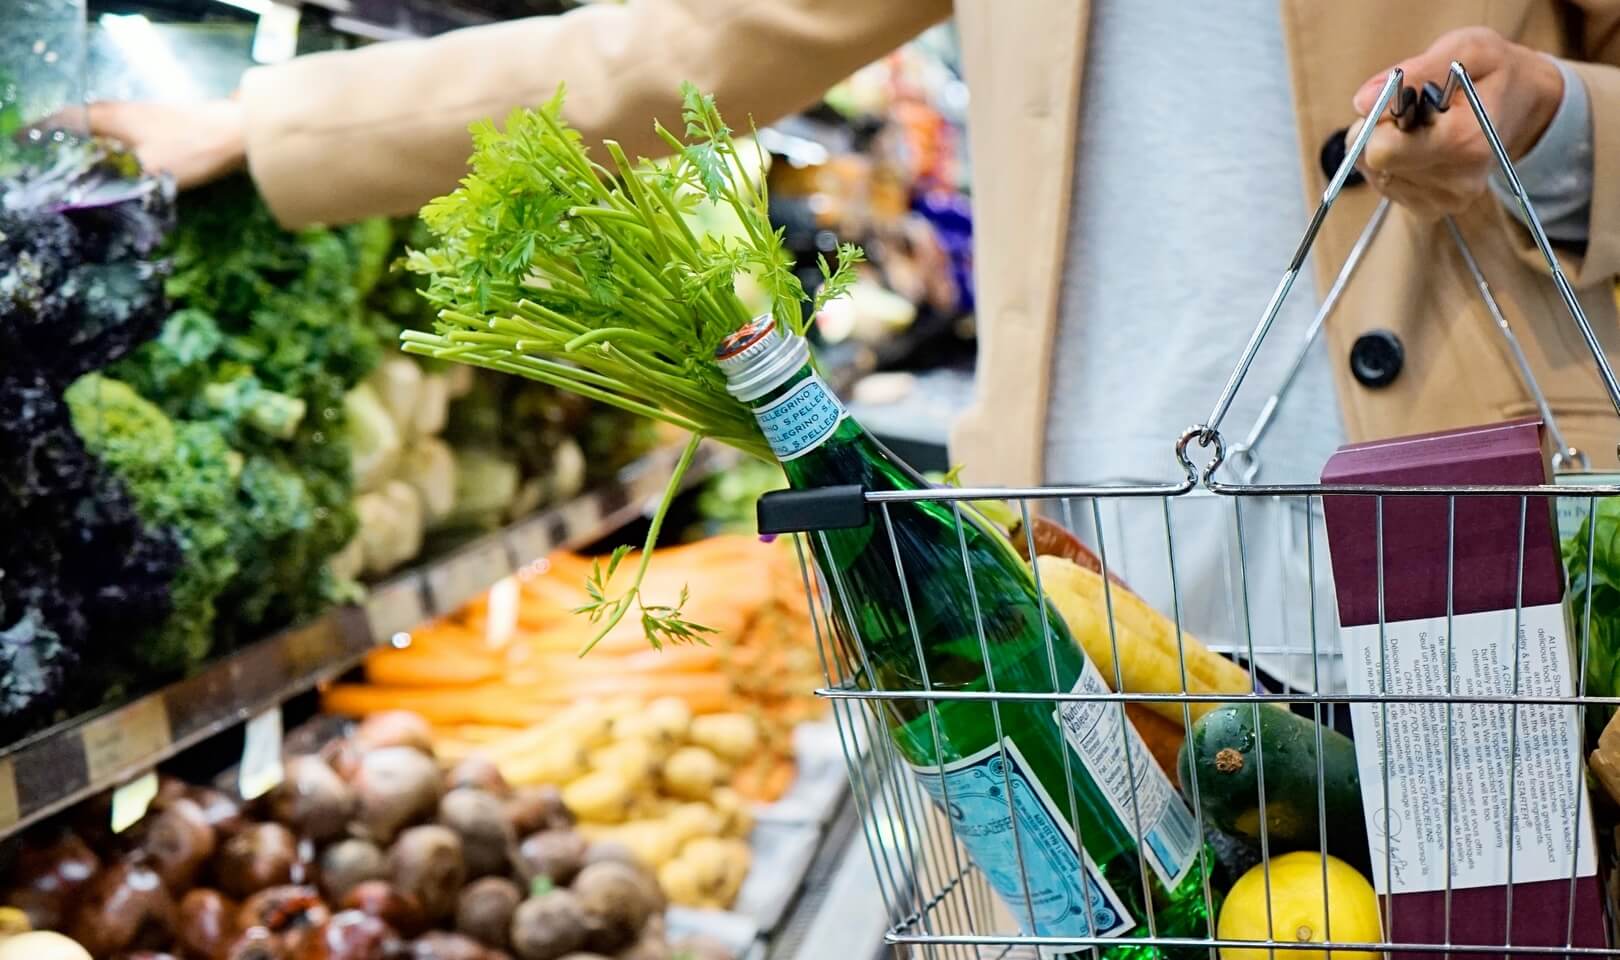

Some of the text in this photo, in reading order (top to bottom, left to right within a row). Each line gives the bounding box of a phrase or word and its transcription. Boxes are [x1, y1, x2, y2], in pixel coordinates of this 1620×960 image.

[1418, 631, 1428, 649] Seul
[1437, 635, 1445, 645] de
[1536, 628, 1547, 662] delicious
[1546, 635, 1555, 644] At
[1363, 646, 1371, 665] vous
[1421, 651, 1428, 662] un
[1487, 642, 1496, 664] these
[1548, 646, 1558, 672] Lesley
[1366, 667, 1373, 677] ne
[1469, 648, 1479, 678] cheese
[1522, 660, 1530, 673] her
[1395, 676, 1402, 686] au
[1411, 659, 1423, 695] supérieu
[1420, 664, 1434, 691] produit
[1451, 674, 1460, 695] Stow
[1490, 667, 1500, 693] unique
[1501, 672, 1511, 697] CRIS
[1524, 676, 1532, 696] team
[1475, 690, 1487, 726] apasto.
[1544, 687, 1553, 710] The
[1068, 709, 1089, 733] Valeur
[1370, 711, 1381, 727] plus
[1390, 710, 1398, 720] de
[1416, 703, 1430, 731] pouvait
[1479, 648, 1505, 796] but really she when topped with your
[1495, 702, 1505, 729] ackers
[1538, 711, 1548, 727] with
[1556, 706, 1564, 719] ine
[1458, 721, 1468, 745] Foods
[1519, 710, 1531, 738] scratch
[1530, 719, 1539, 732] the
[1548, 712, 1558, 745] fabulous
[1558, 721, 1568, 745] Foods
[1429, 643, 1437, 662] avec
[1434, 685, 1441, 695] en
[1453, 825, 1462, 835] de
[1471, 730, 1479, 743] are
[1480, 728, 1489, 741] We
[1499, 731, 1507, 743] are
[1532, 735, 1541, 750] only
[1540, 729, 1549, 747] care
[1403, 735, 1415, 775] craquelins
[1403, 671, 1434, 842] CRAEZ POUR CES FINS CRAQUELINS
[1422, 733, 1434, 768] satisfaire
[1451, 737, 1461, 770] fabuleux
[1461, 747, 1470, 769] adore
[1473, 746, 1481, 763] sure
[1482, 744, 1490, 757] are
[1523, 740, 1533, 761] using
[1543, 748, 1551, 756] in
[1552, 748, 1562, 770] crisps
[1562, 748, 1569, 759] we
[1397, 763, 1406, 773] de
[1435, 757, 1443, 775] avec
[1534, 753, 1542, 768] way
[1544, 758, 1555, 779] small
[1563, 761, 1572, 777] love
[1474, 765, 1484, 779] you
[1485, 759, 1497, 792] addicted
[1537, 770, 1545, 778] to
[1399, 775, 1409, 807] fromage
[1408, 777, 1418, 794] sont
[1427, 770, 1437, 794] Lesley
[1438, 777, 1446, 791] des
[1464, 771, 1475, 805] fabriquer
[1478, 782, 1488, 793] will
[1529, 778, 1539, 799] finest
[1538, 781, 1548, 801] make
[1556, 773, 1564, 791] from
[1455, 772, 1468, 812] craquelins
[1480, 795, 1489, 806] be
[1489, 794, 1497, 802] to
[1404, 809, 1411, 819] ou
[1469, 808, 1478, 816] et
[1491, 804, 1500, 818] this
[1559, 793, 1570, 824] Lesley's
[1461, 814, 1471, 831] sont
[1471, 818, 1479, 836] vous
[1540, 811, 1553, 830] great
[1491, 820, 1502, 848] yummy
[1513, 834, 1521, 850] own
[1474, 838, 1483, 856] offrir
[1544, 833, 1557, 862] product
